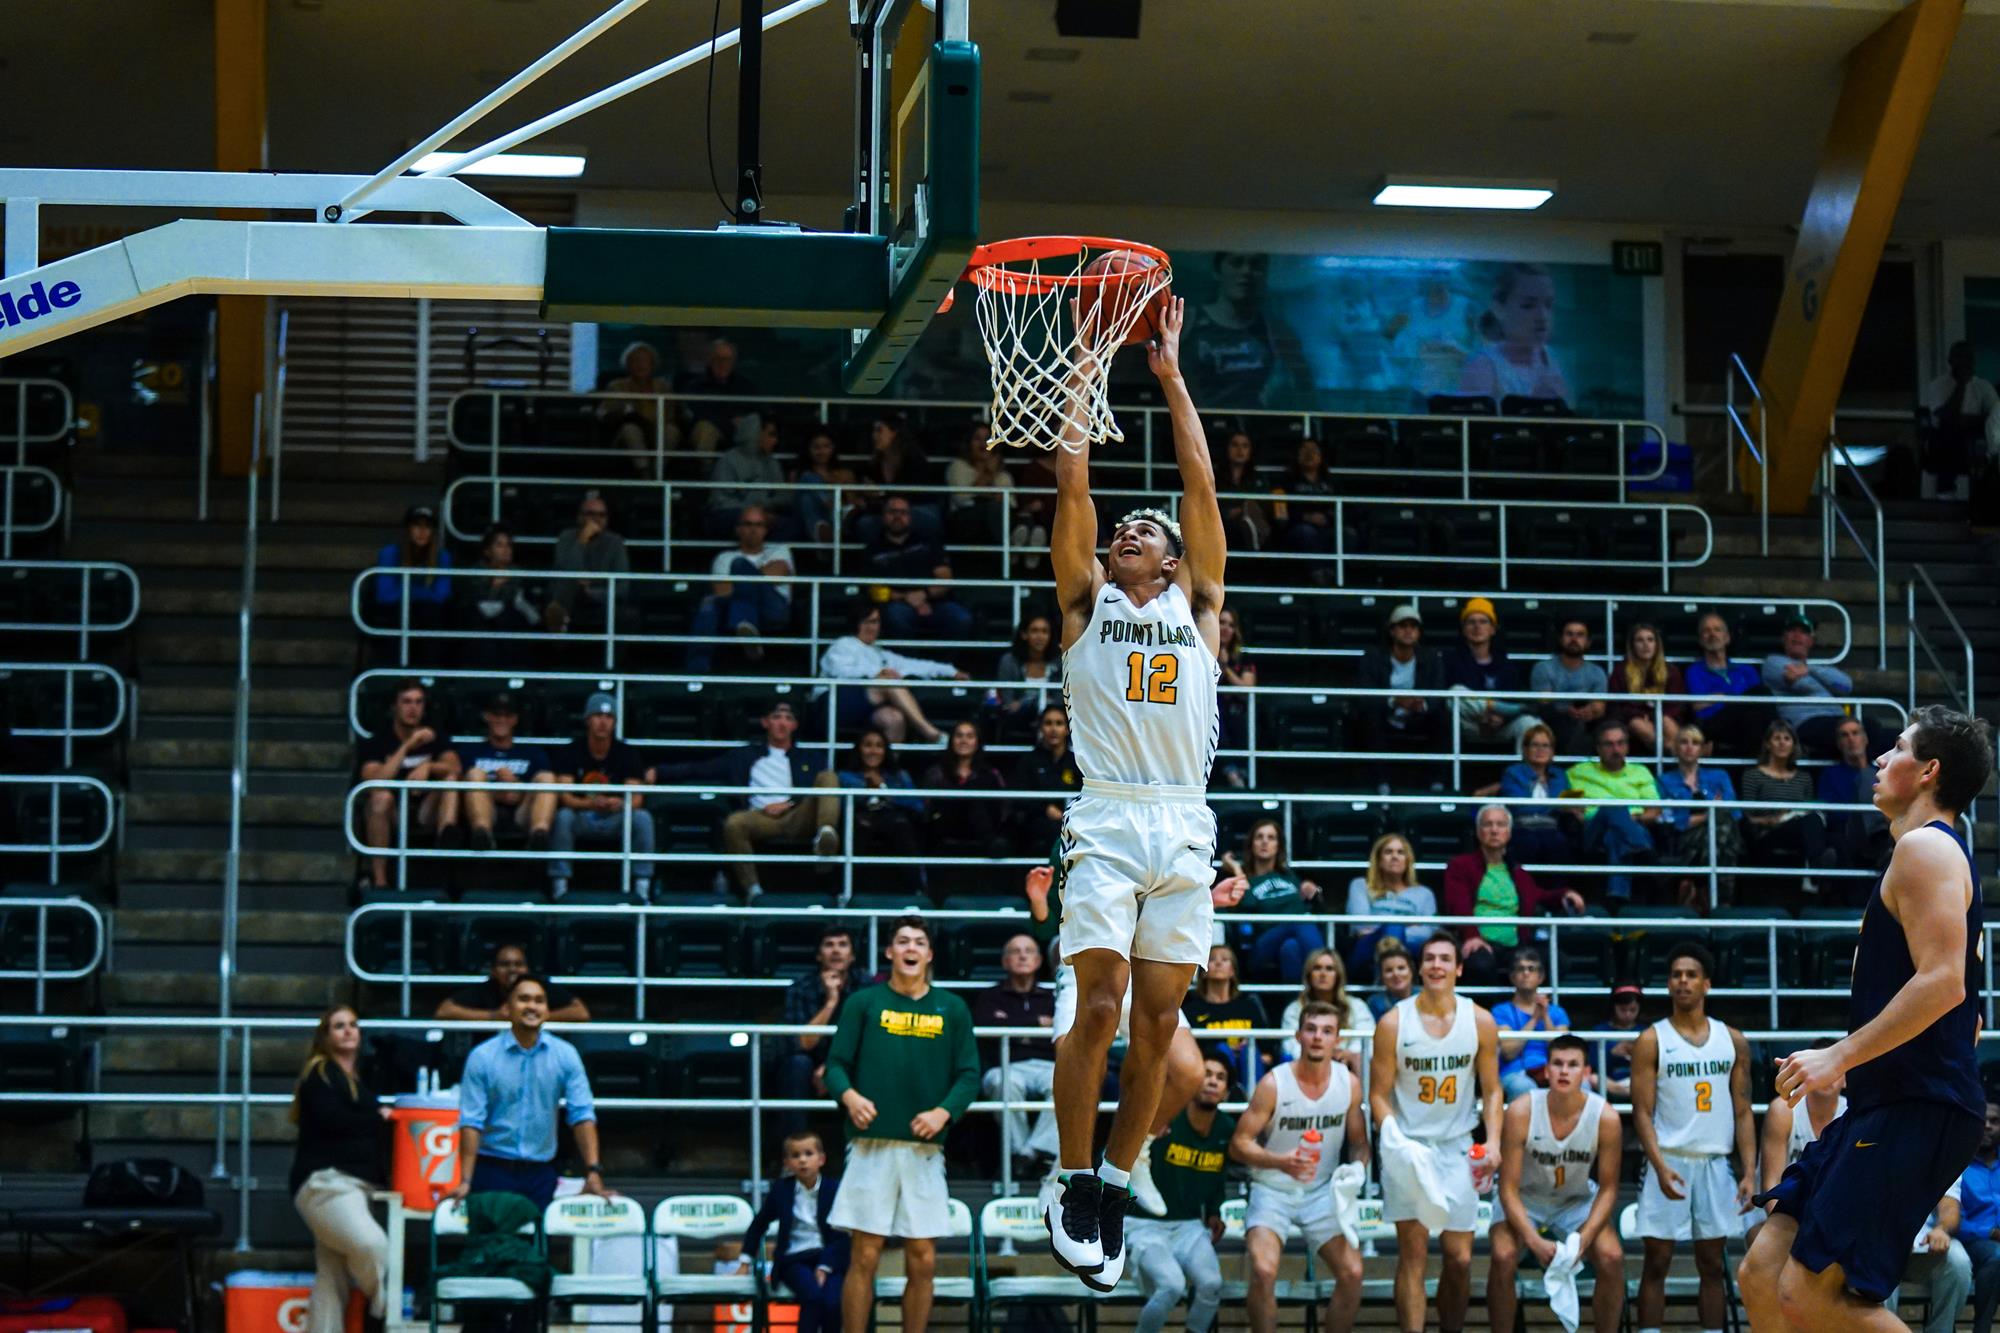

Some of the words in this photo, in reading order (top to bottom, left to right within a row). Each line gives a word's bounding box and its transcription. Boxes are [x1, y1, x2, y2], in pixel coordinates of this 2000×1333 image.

[0, 280, 82, 330] lde
[1100, 620, 1153, 647] POINT
[1126, 651, 1178, 705] 12
[1404, 1056, 1438, 1071] POINT
[1667, 1062, 1701, 1078] POINT
[1418, 1074, 1457, 1105] 34
[1694, 1081, 1713, 1112] 2
[1279, 1115, 1314, 1131] POINT
[424, 1126, 453, 1155] G
[1166, 1143, 1200, 1165] POINT
[1553, 1165, 1567, 1189] 1
[561, 1203, 593, 1217] POINT
[670, 1203, 703, 1217] POINT
[706, 1203, 737, 1217] LOMA
[277, 1298, 309, 1333] G
